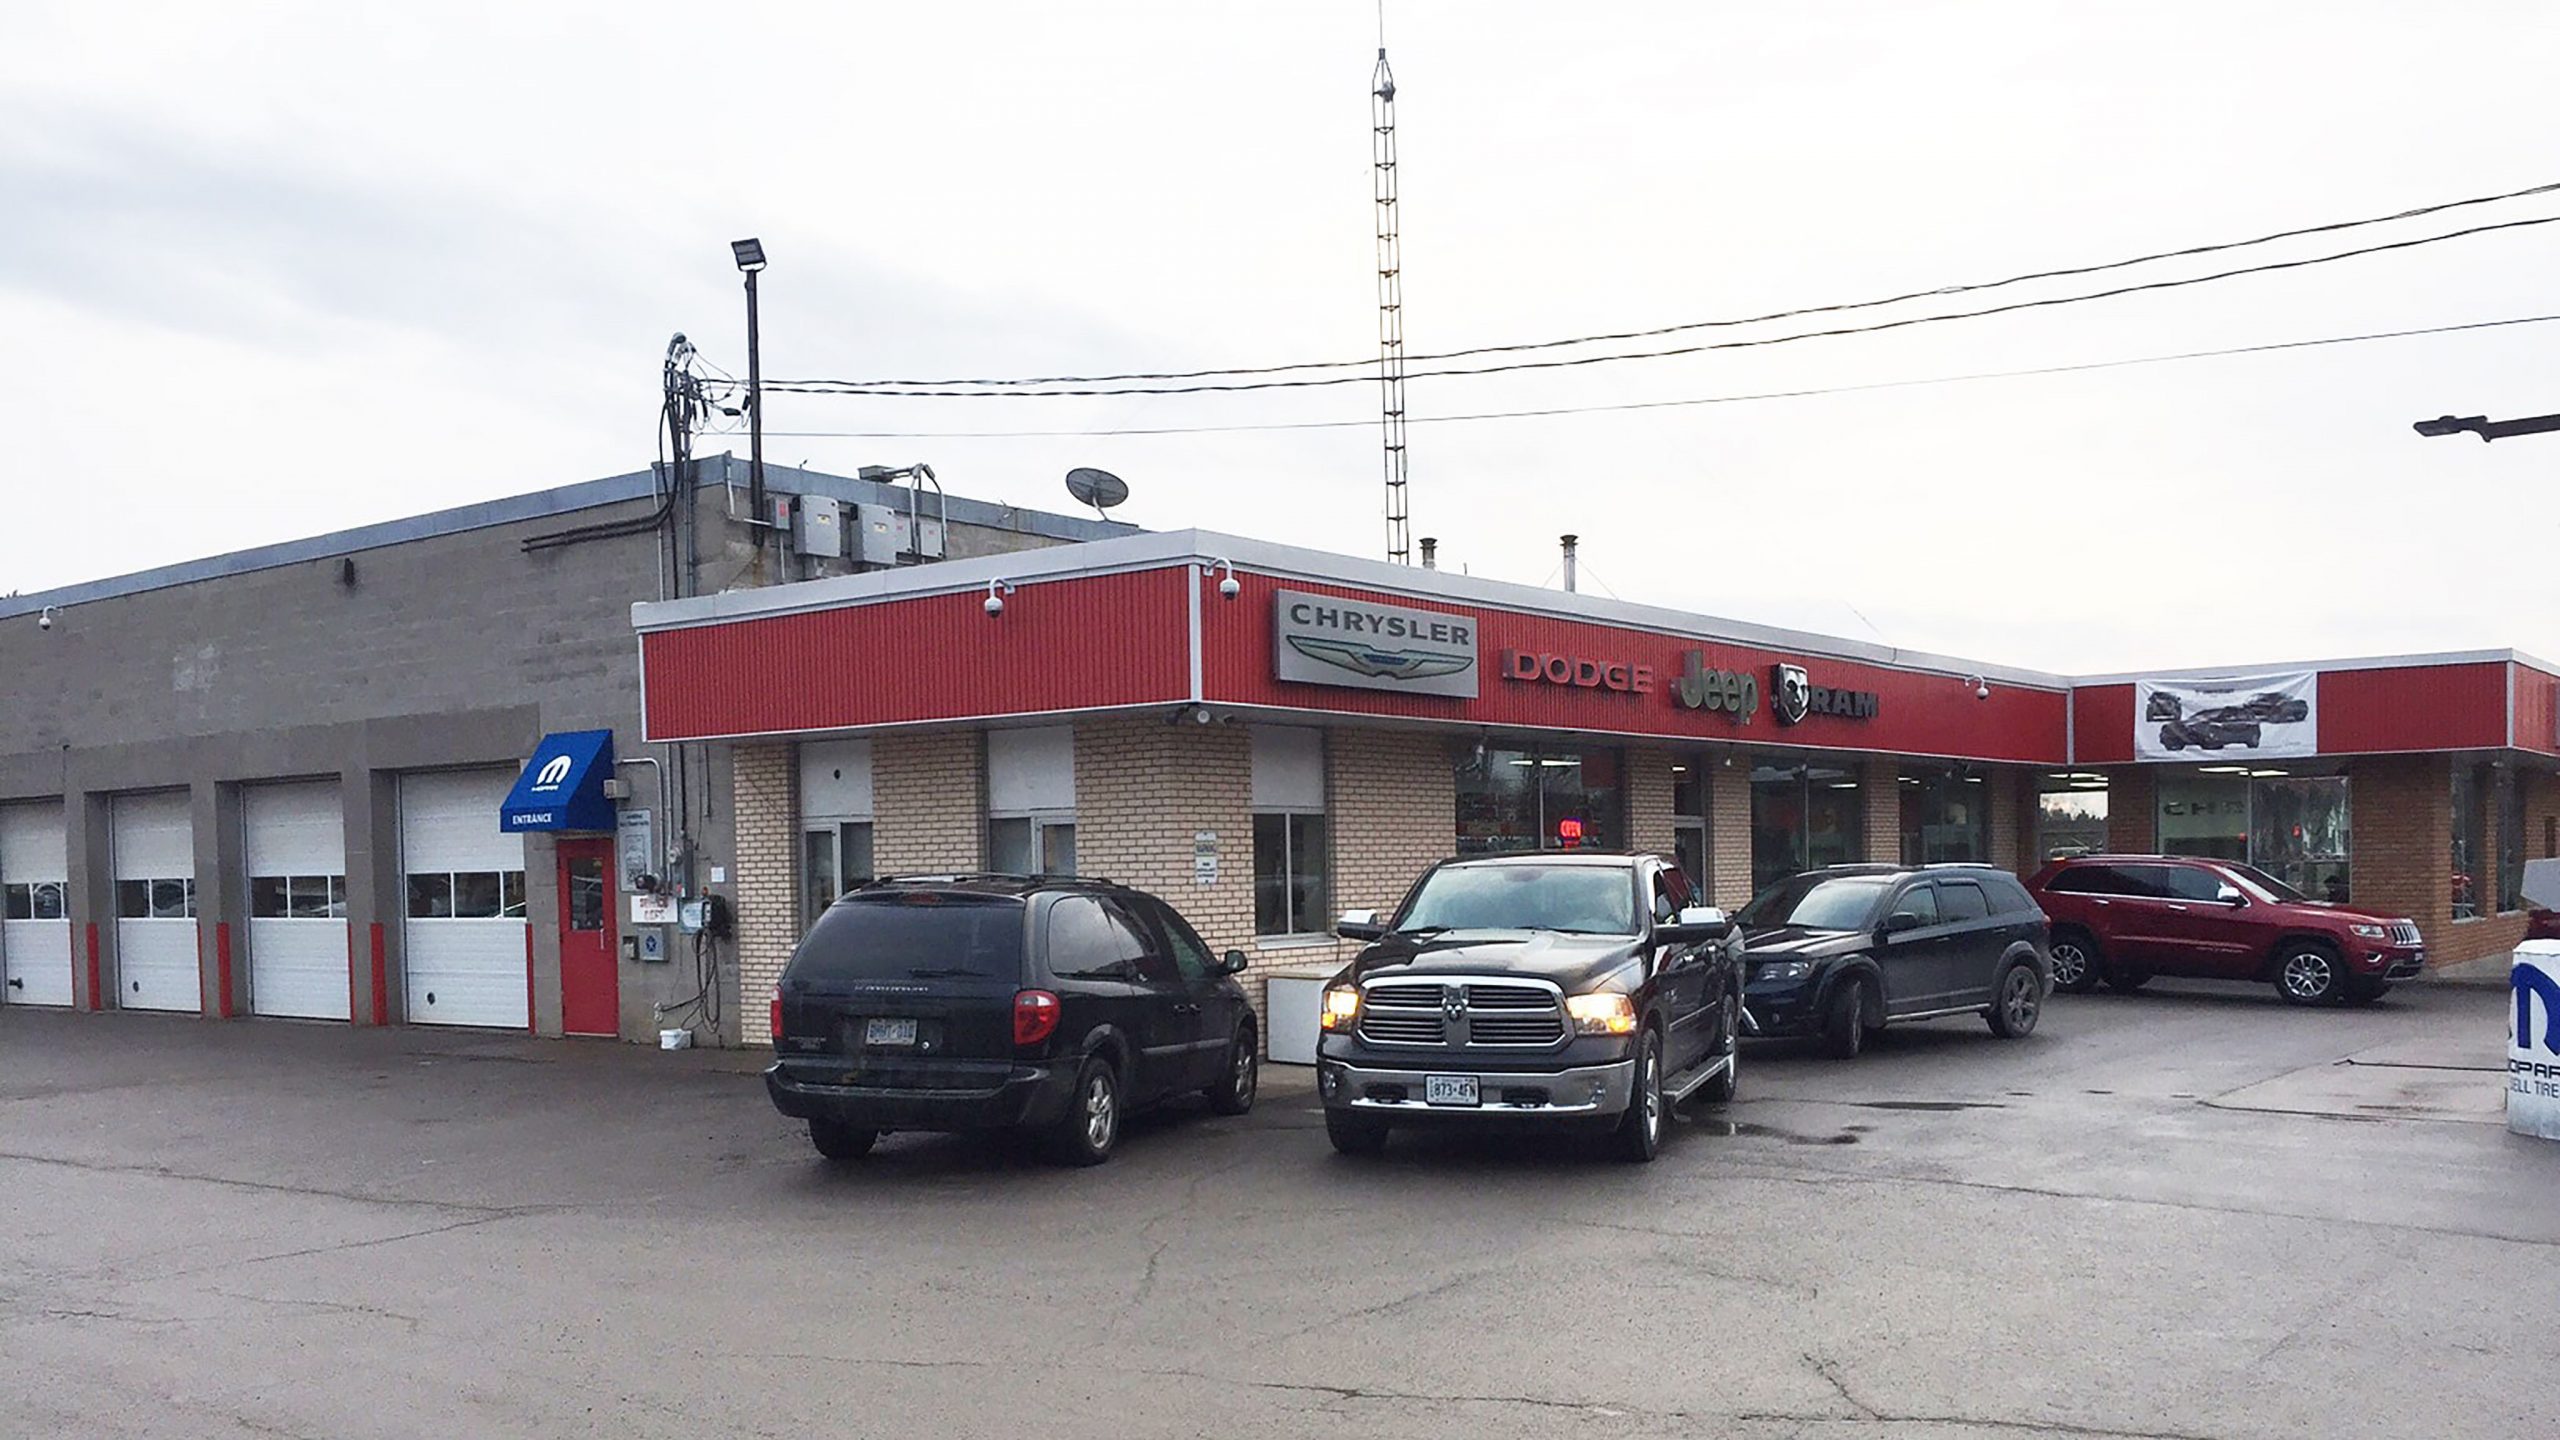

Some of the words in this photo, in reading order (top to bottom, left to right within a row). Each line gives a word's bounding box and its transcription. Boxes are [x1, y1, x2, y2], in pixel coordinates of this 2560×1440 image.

[1290, 603, 1470, 646] CHRYSLER
[1506, 650, 1654, 694] DODGE
[1675, 649, 1759, 725] Jeep
[1808, 685, 1879, 719] RAM
[512, 812, 553, 826] ENTRANCE
[1560, 820, 1582, 837] OPEN
